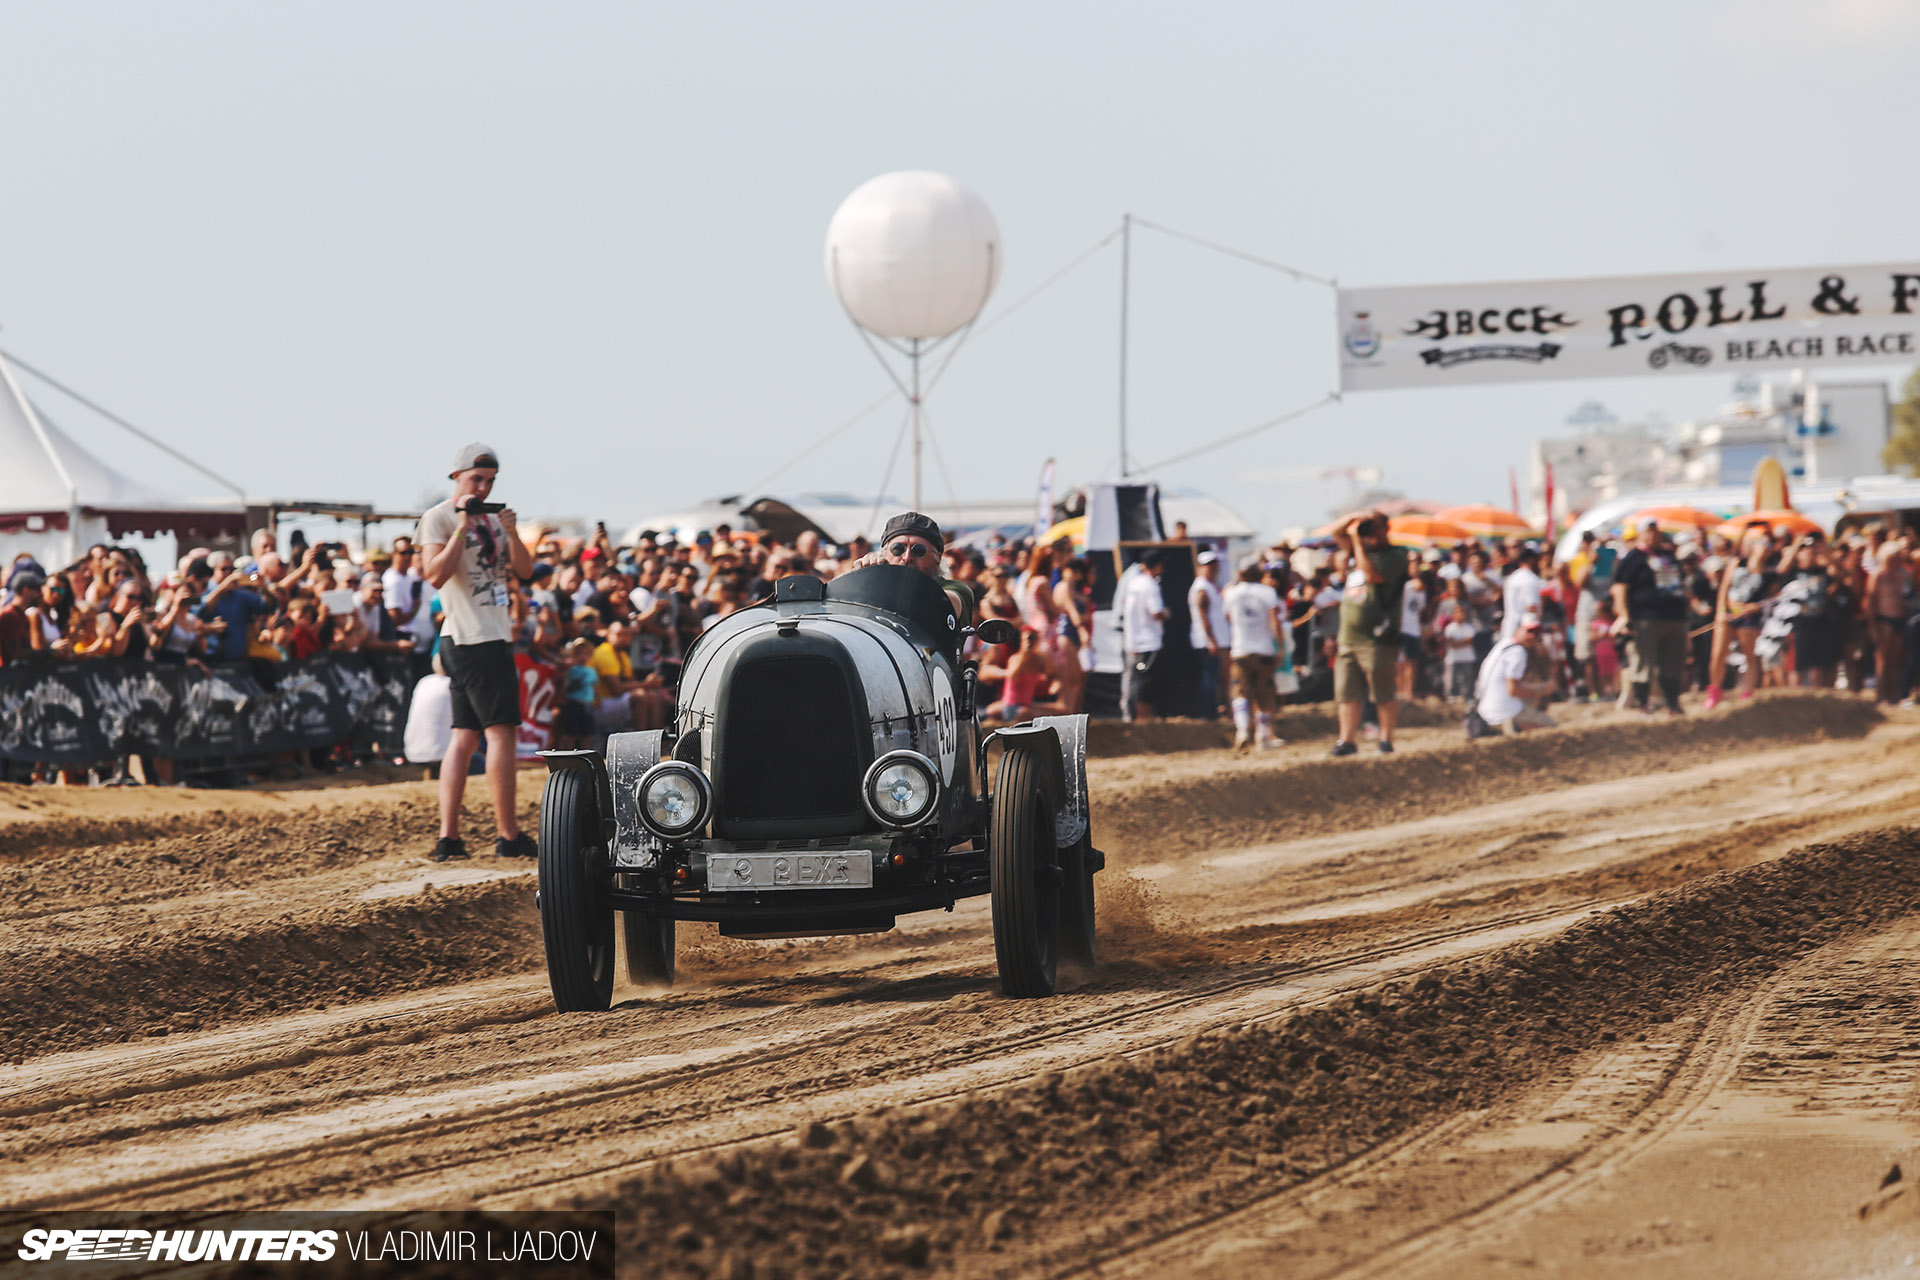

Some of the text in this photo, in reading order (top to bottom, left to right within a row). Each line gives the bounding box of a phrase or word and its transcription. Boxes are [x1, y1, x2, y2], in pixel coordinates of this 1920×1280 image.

[1607, 280, 1787, 348] ROLL
[1811, 273, 1861, 316] &
[1726, 332, 1914, 362] BEACH RACE
